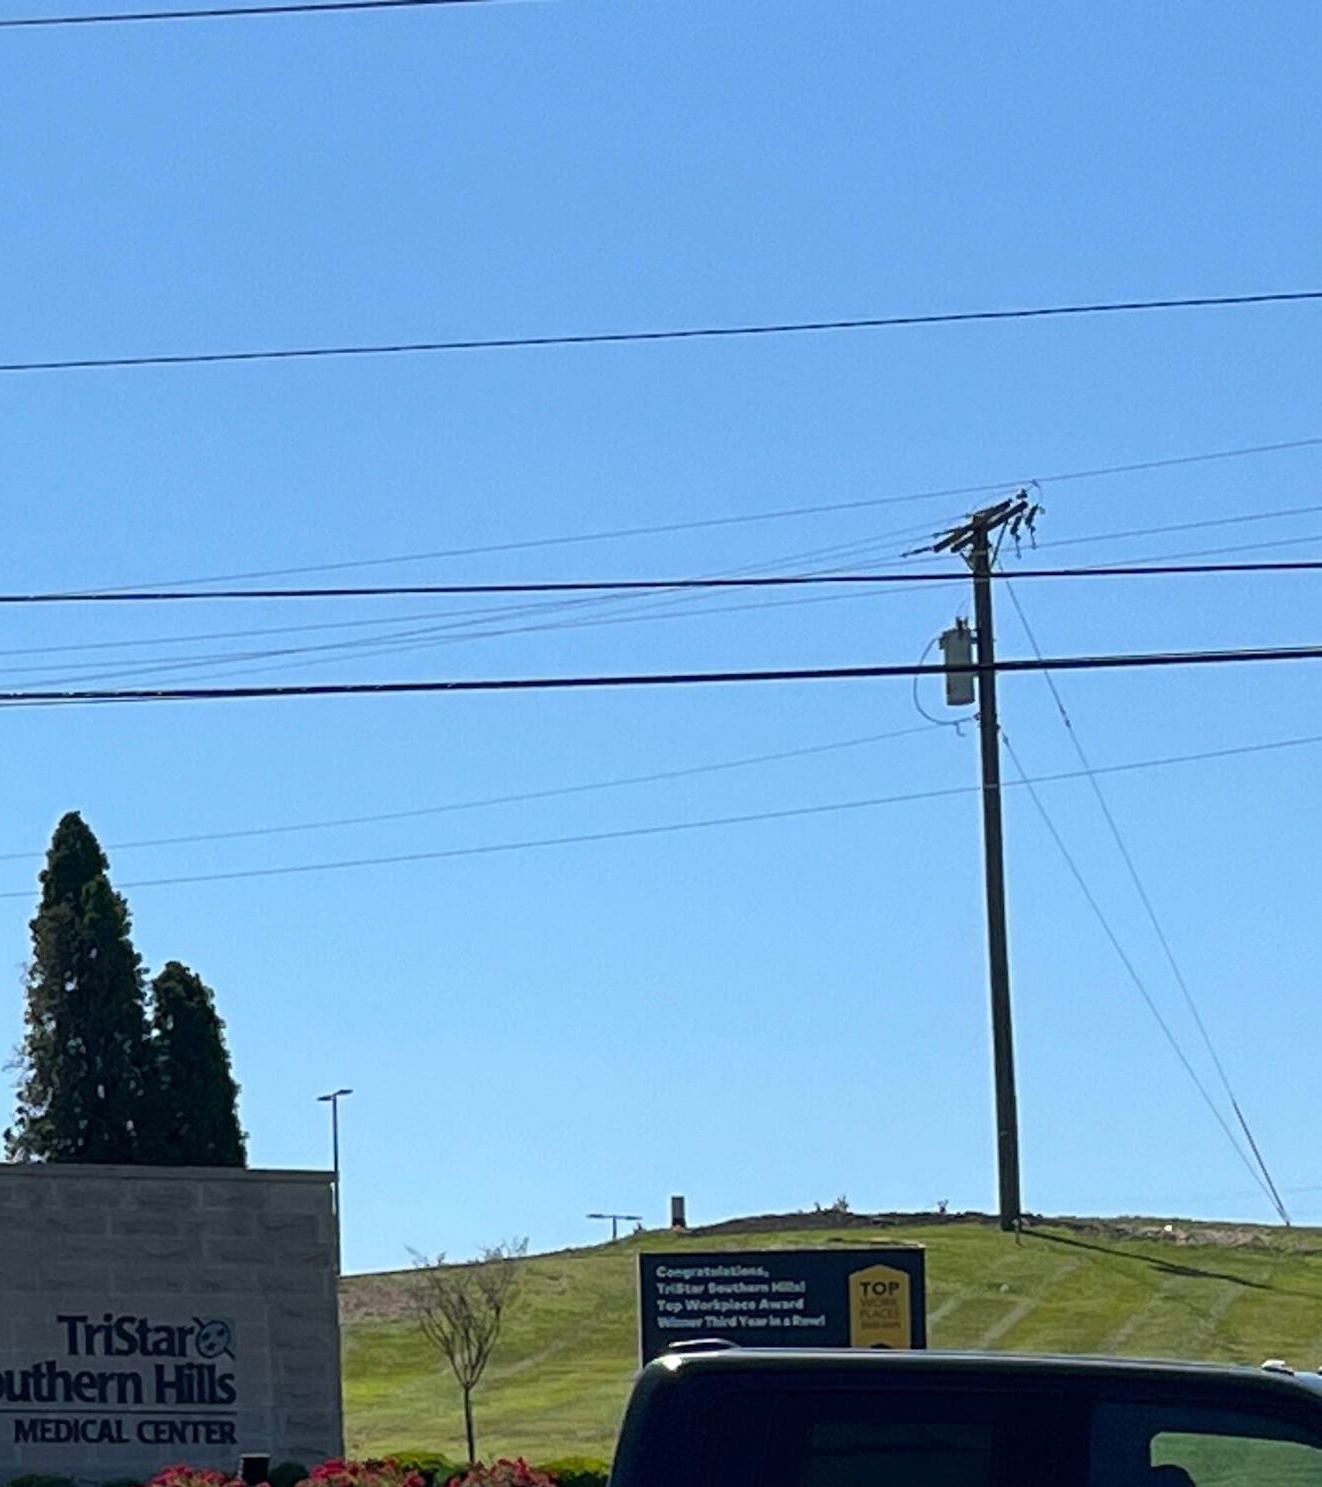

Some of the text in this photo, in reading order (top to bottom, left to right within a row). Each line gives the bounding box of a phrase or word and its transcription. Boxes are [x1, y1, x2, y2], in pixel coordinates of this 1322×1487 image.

[708, 1282, 769, 1293] Southern
[860, 1282, 900, 1296] TOP
[657, 1299, 804, 1313] Top Workplace Award
[705, 1316, 737, 1327] Third
[738, 1316, 768, 1327] Year
[57, 1313, 194, 1357] TriStar
[154, 1362, 237, 1405] Hills
[14, 1419, 237, 1445] MEDICAL CENTER
